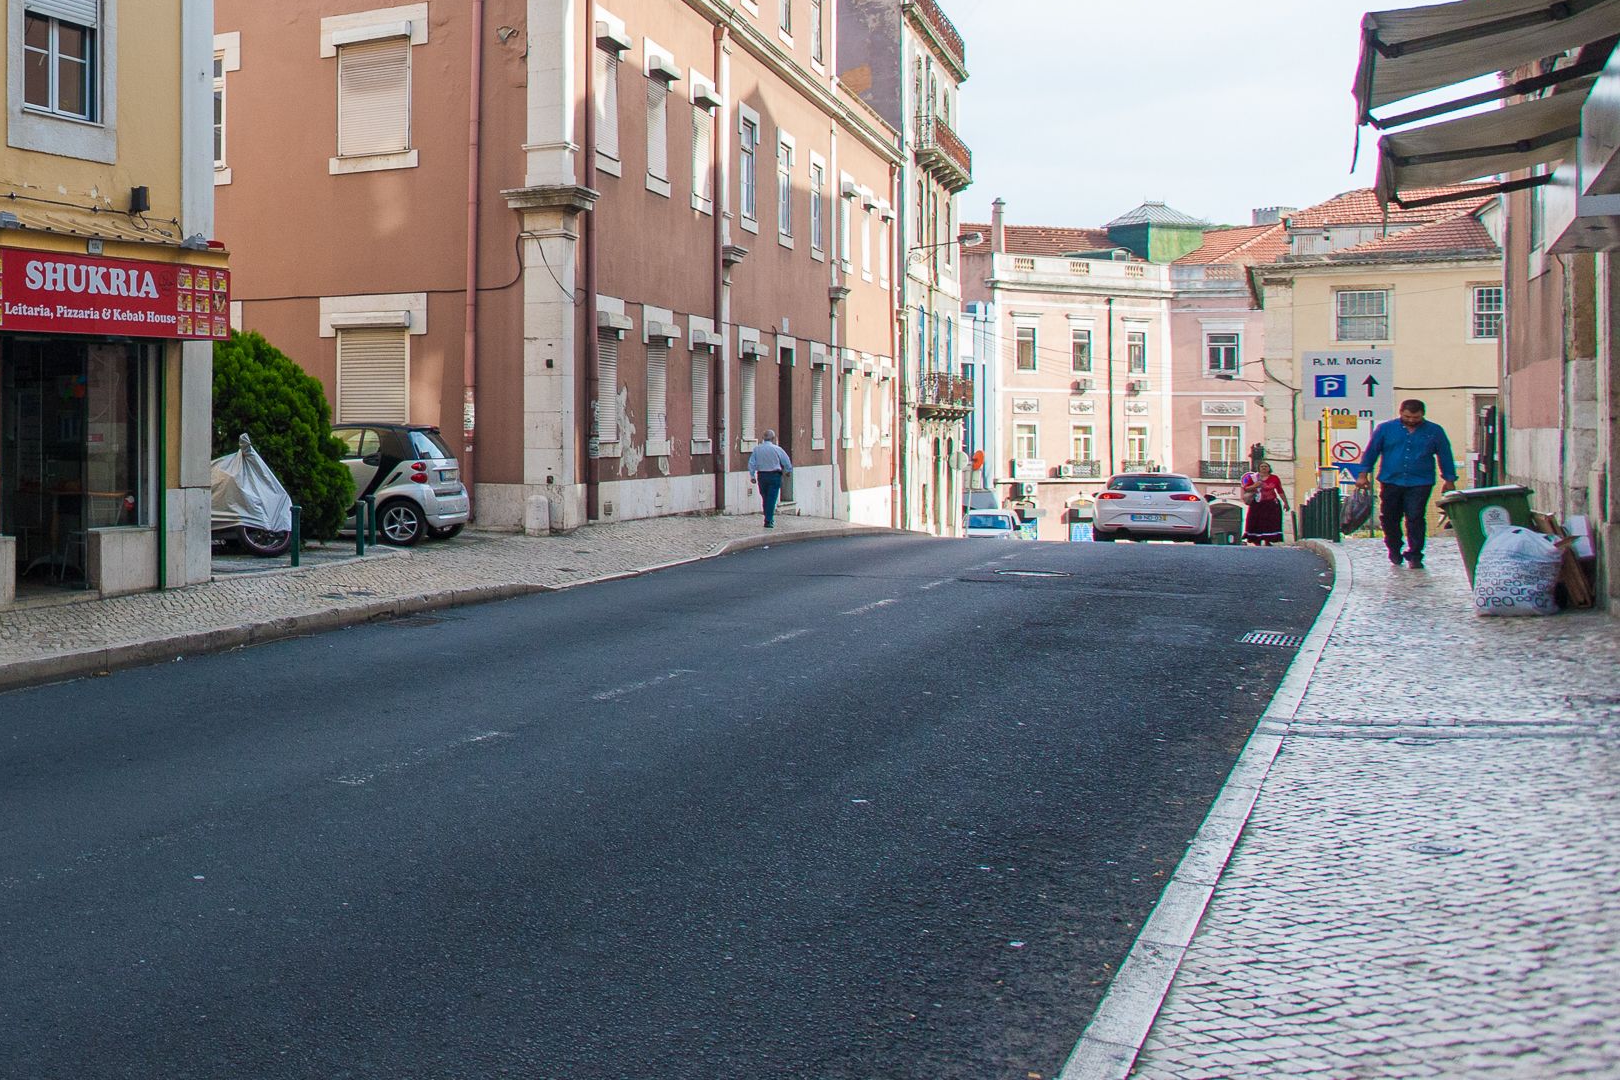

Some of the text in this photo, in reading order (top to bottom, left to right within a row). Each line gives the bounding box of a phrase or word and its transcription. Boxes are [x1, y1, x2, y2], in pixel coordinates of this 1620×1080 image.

[25, 260, 159, 299] SHUKRIA
[4, 301, 177, 324] Leitaria, Pizzaria & Kebab House
[1345, 357, 1382, 365] Moniz
[1323, 380, 1339, 396] P
[1321, 407, 1373, 418] 00 m
[1491, 579, 1522, 587] area
[1476, 596, 1515, 608] area
